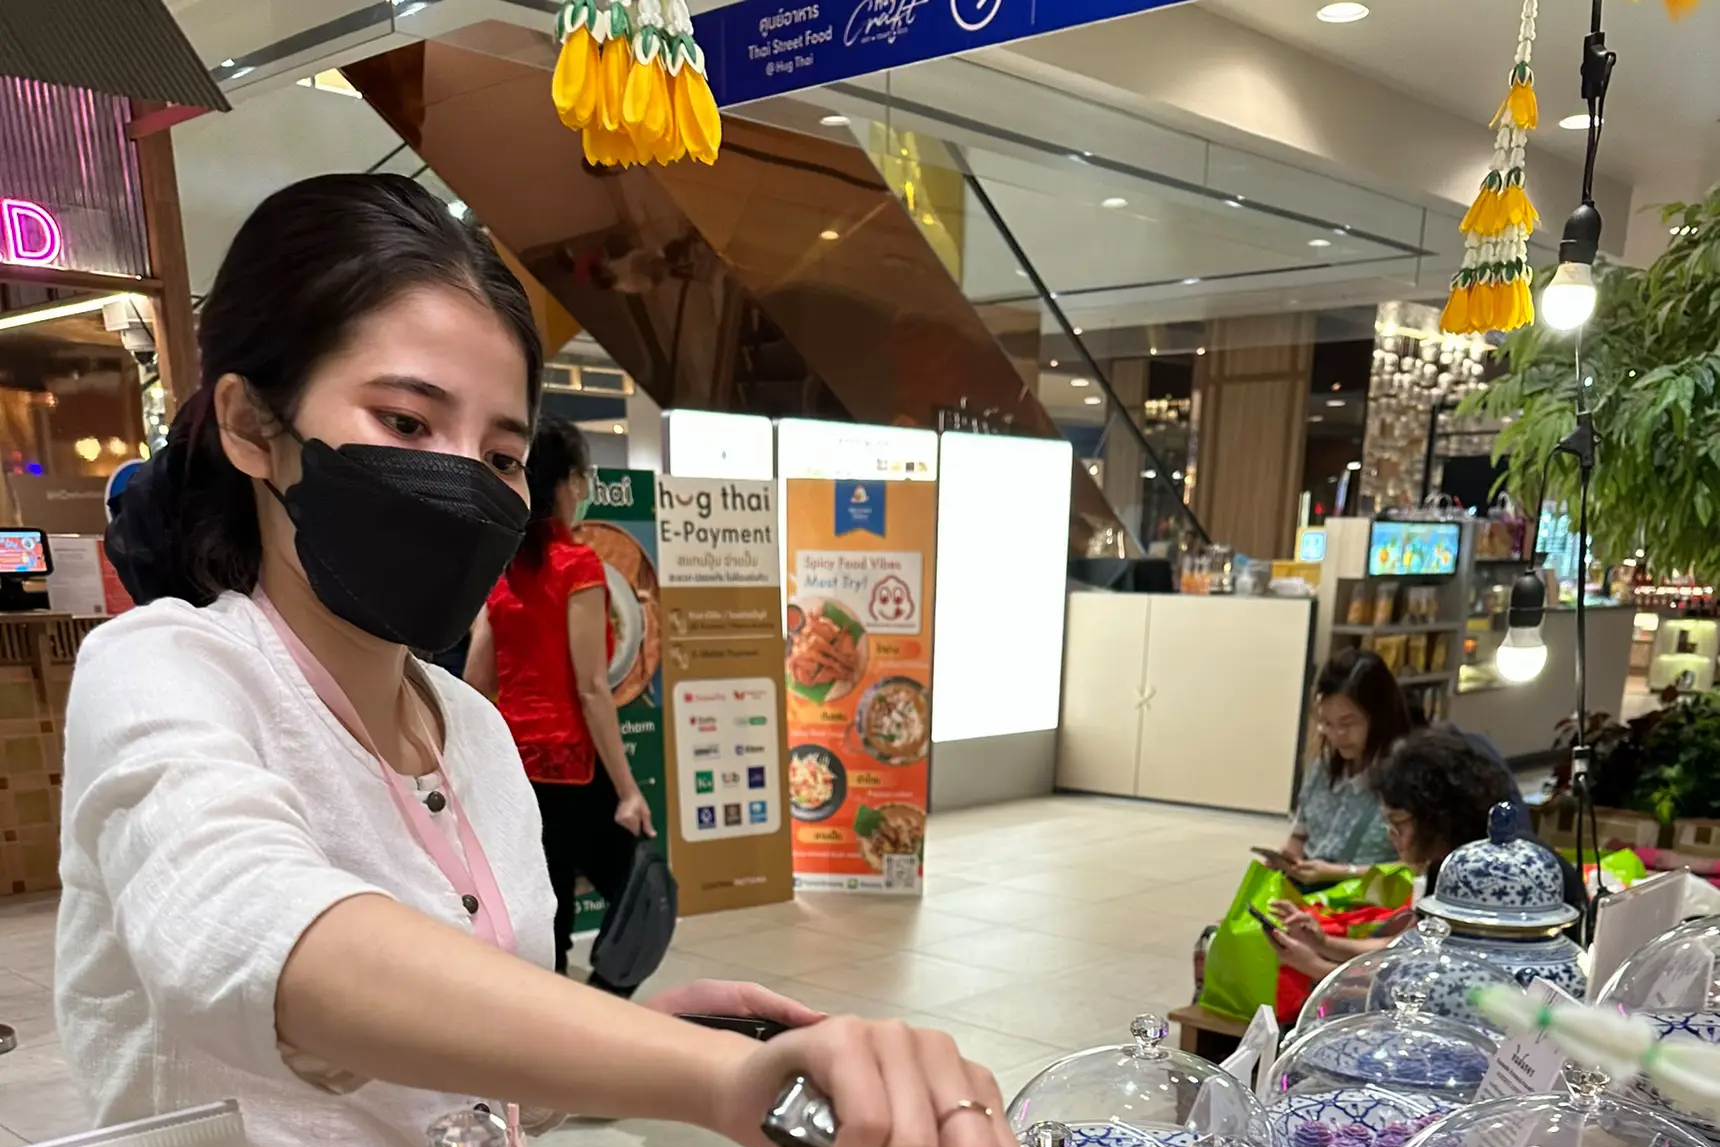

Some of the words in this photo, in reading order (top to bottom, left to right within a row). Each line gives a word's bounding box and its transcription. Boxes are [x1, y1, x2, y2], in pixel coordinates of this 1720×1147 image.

[759, 4, 819, 37] ศูนย์อาหาร
[748, 42, 771, 60] Thai
[772, 34, 803, 54] Street
[805, 24, 833, 46] Food
[795, 52, 814, 68] Thai
[0, 198, 61, 265] D
[591, 465, 634, 507] hai
[658, 481, 712, 519] hug
[721, 483, 770, 512] thai
[660, 520, 772, 549] E-Payment
[804, 556, 835, 571] Spicy
[838, 556, 868, 570] Food
[868, 556, 902, 570] Vibes
[804, 574, 838, 588] Must
[842, 574, 868, 594] Try!
